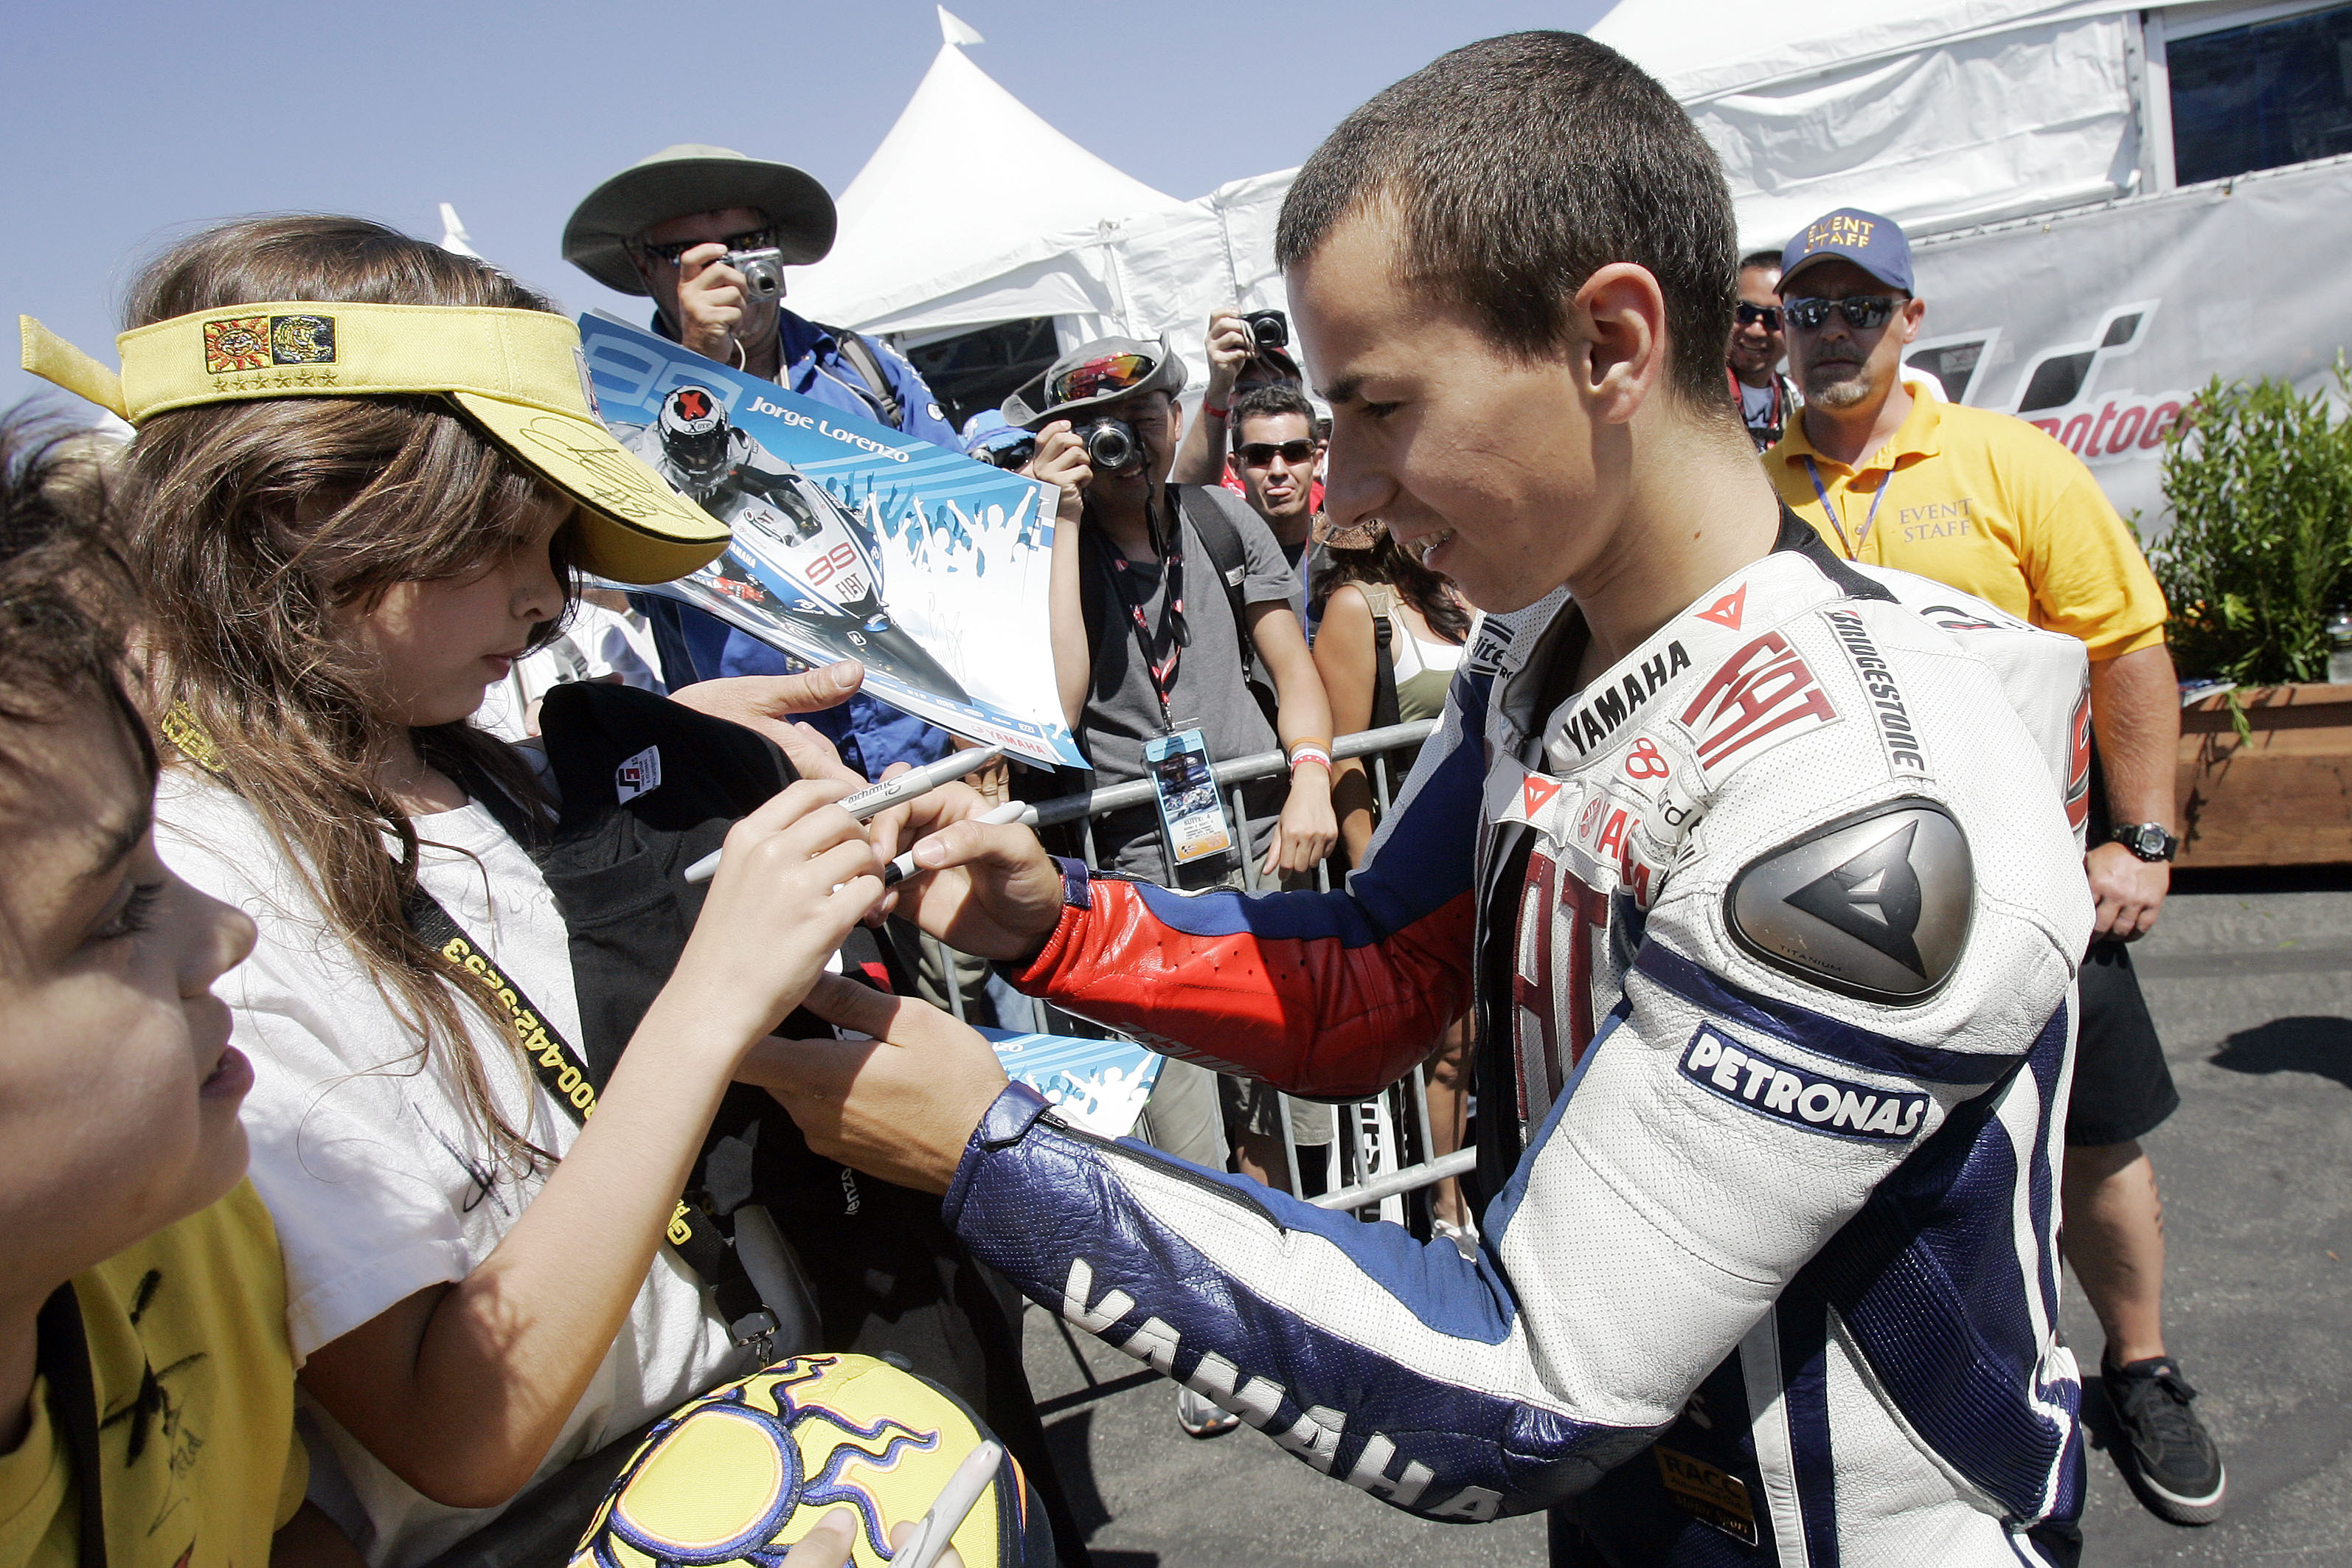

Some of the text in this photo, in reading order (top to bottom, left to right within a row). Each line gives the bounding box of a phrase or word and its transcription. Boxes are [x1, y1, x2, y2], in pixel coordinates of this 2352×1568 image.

[1804, 232, 1870, 254] STAFF
[1807, 215, 1875, 240] EVENT
[746, 395, 815, 431] Jorge
[818, 420, 911, 464] Lorenzo
[1898, 498, 1974, 525] EVENT
[1904, 518, 1972, 544] STAFF
[805, 542, 857, 587] 99
[834, 572, 867, 603] FIAT
[1562, 640, 1692, 757] YAMAHA
[1680, 630, 1839, 771] FIAT
[1826, 610, 1926, 774] BRIDGESTONE
[985, 727, 1047, 755] YAMAHA
[1780, 944, 1842, 973] TITANIUM
[1687, 1032, 1925, 1135] PETRONAS
[1063, 1257, 1505, 1524] YAMAHA
